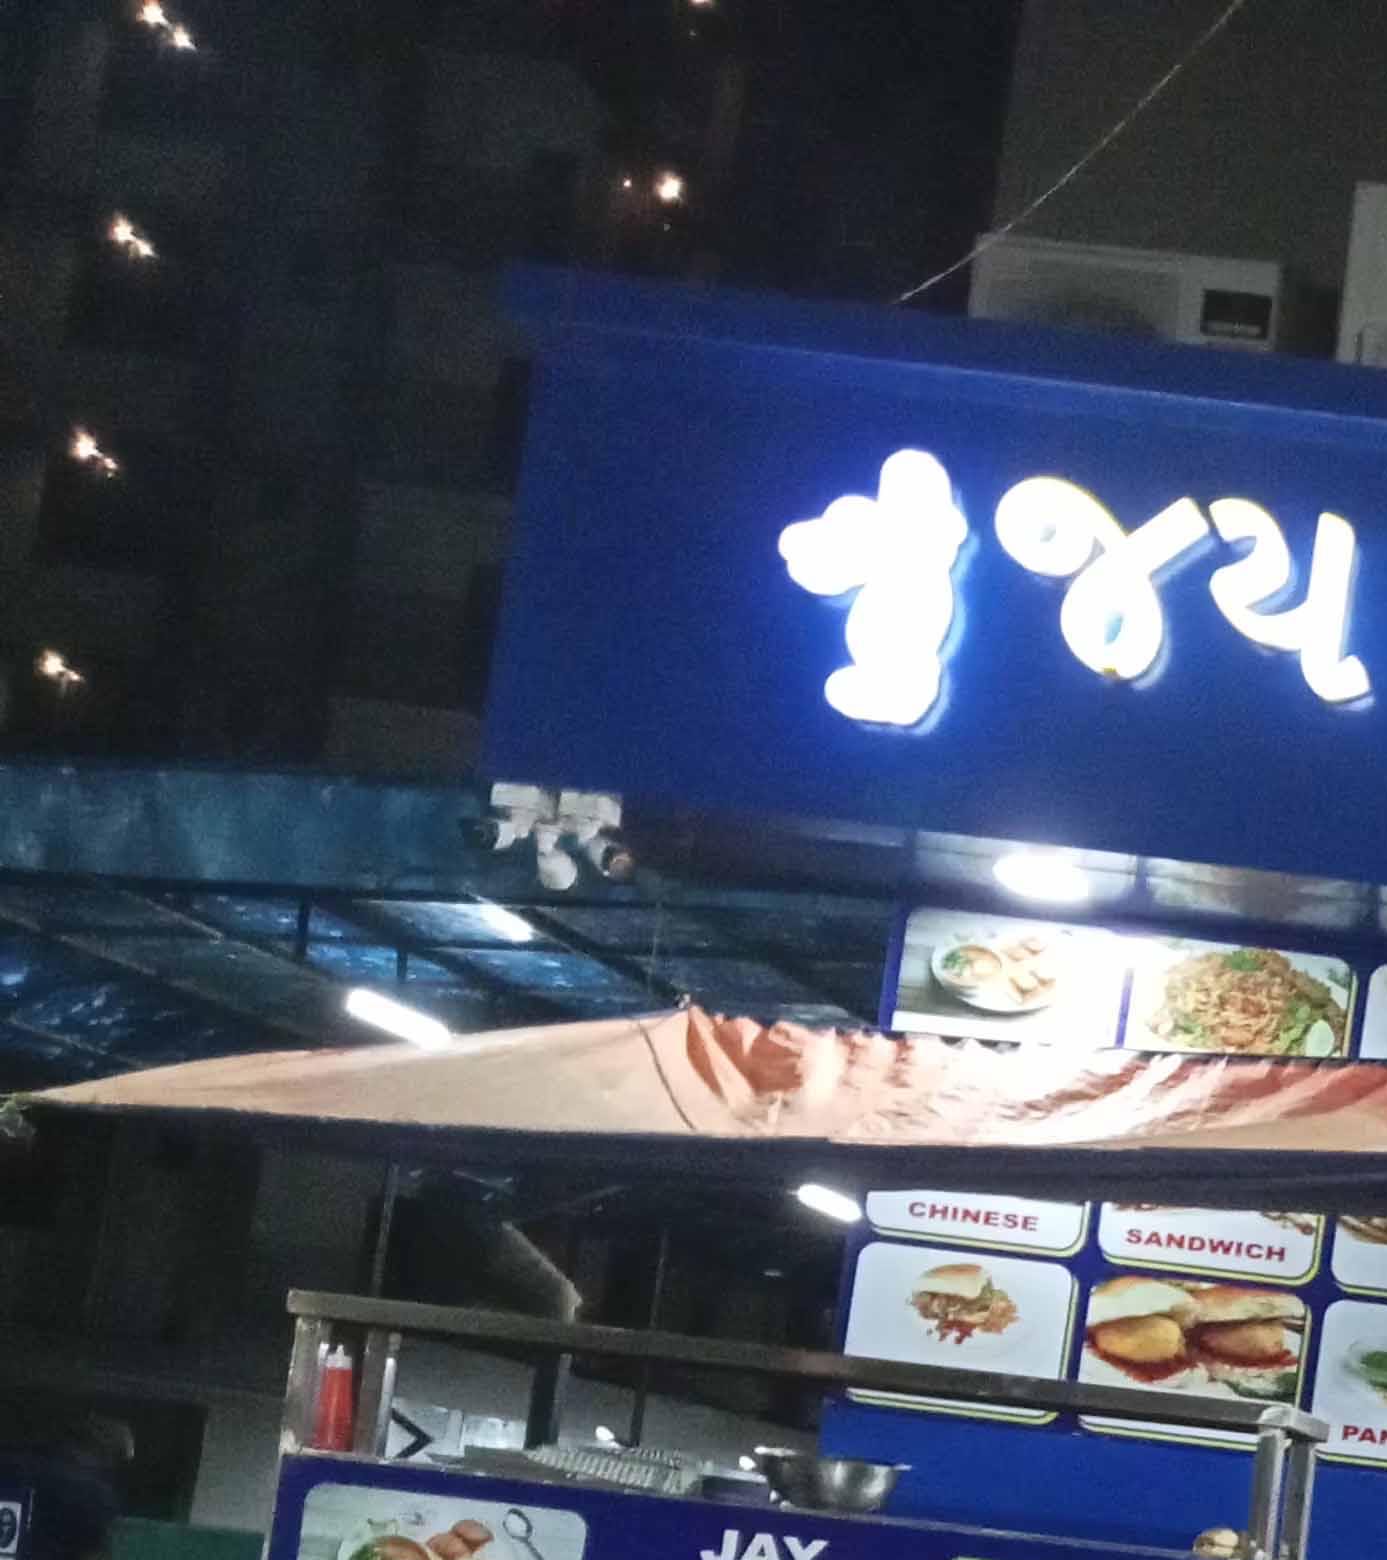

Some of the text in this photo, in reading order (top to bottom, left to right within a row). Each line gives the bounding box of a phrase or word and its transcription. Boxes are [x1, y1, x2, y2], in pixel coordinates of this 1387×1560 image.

[995, 476, 1372, 704] જય
[908, 1201, 1039, 1233] CHINESE
[1126, 1227, 1287, 1263] SANDWICH
